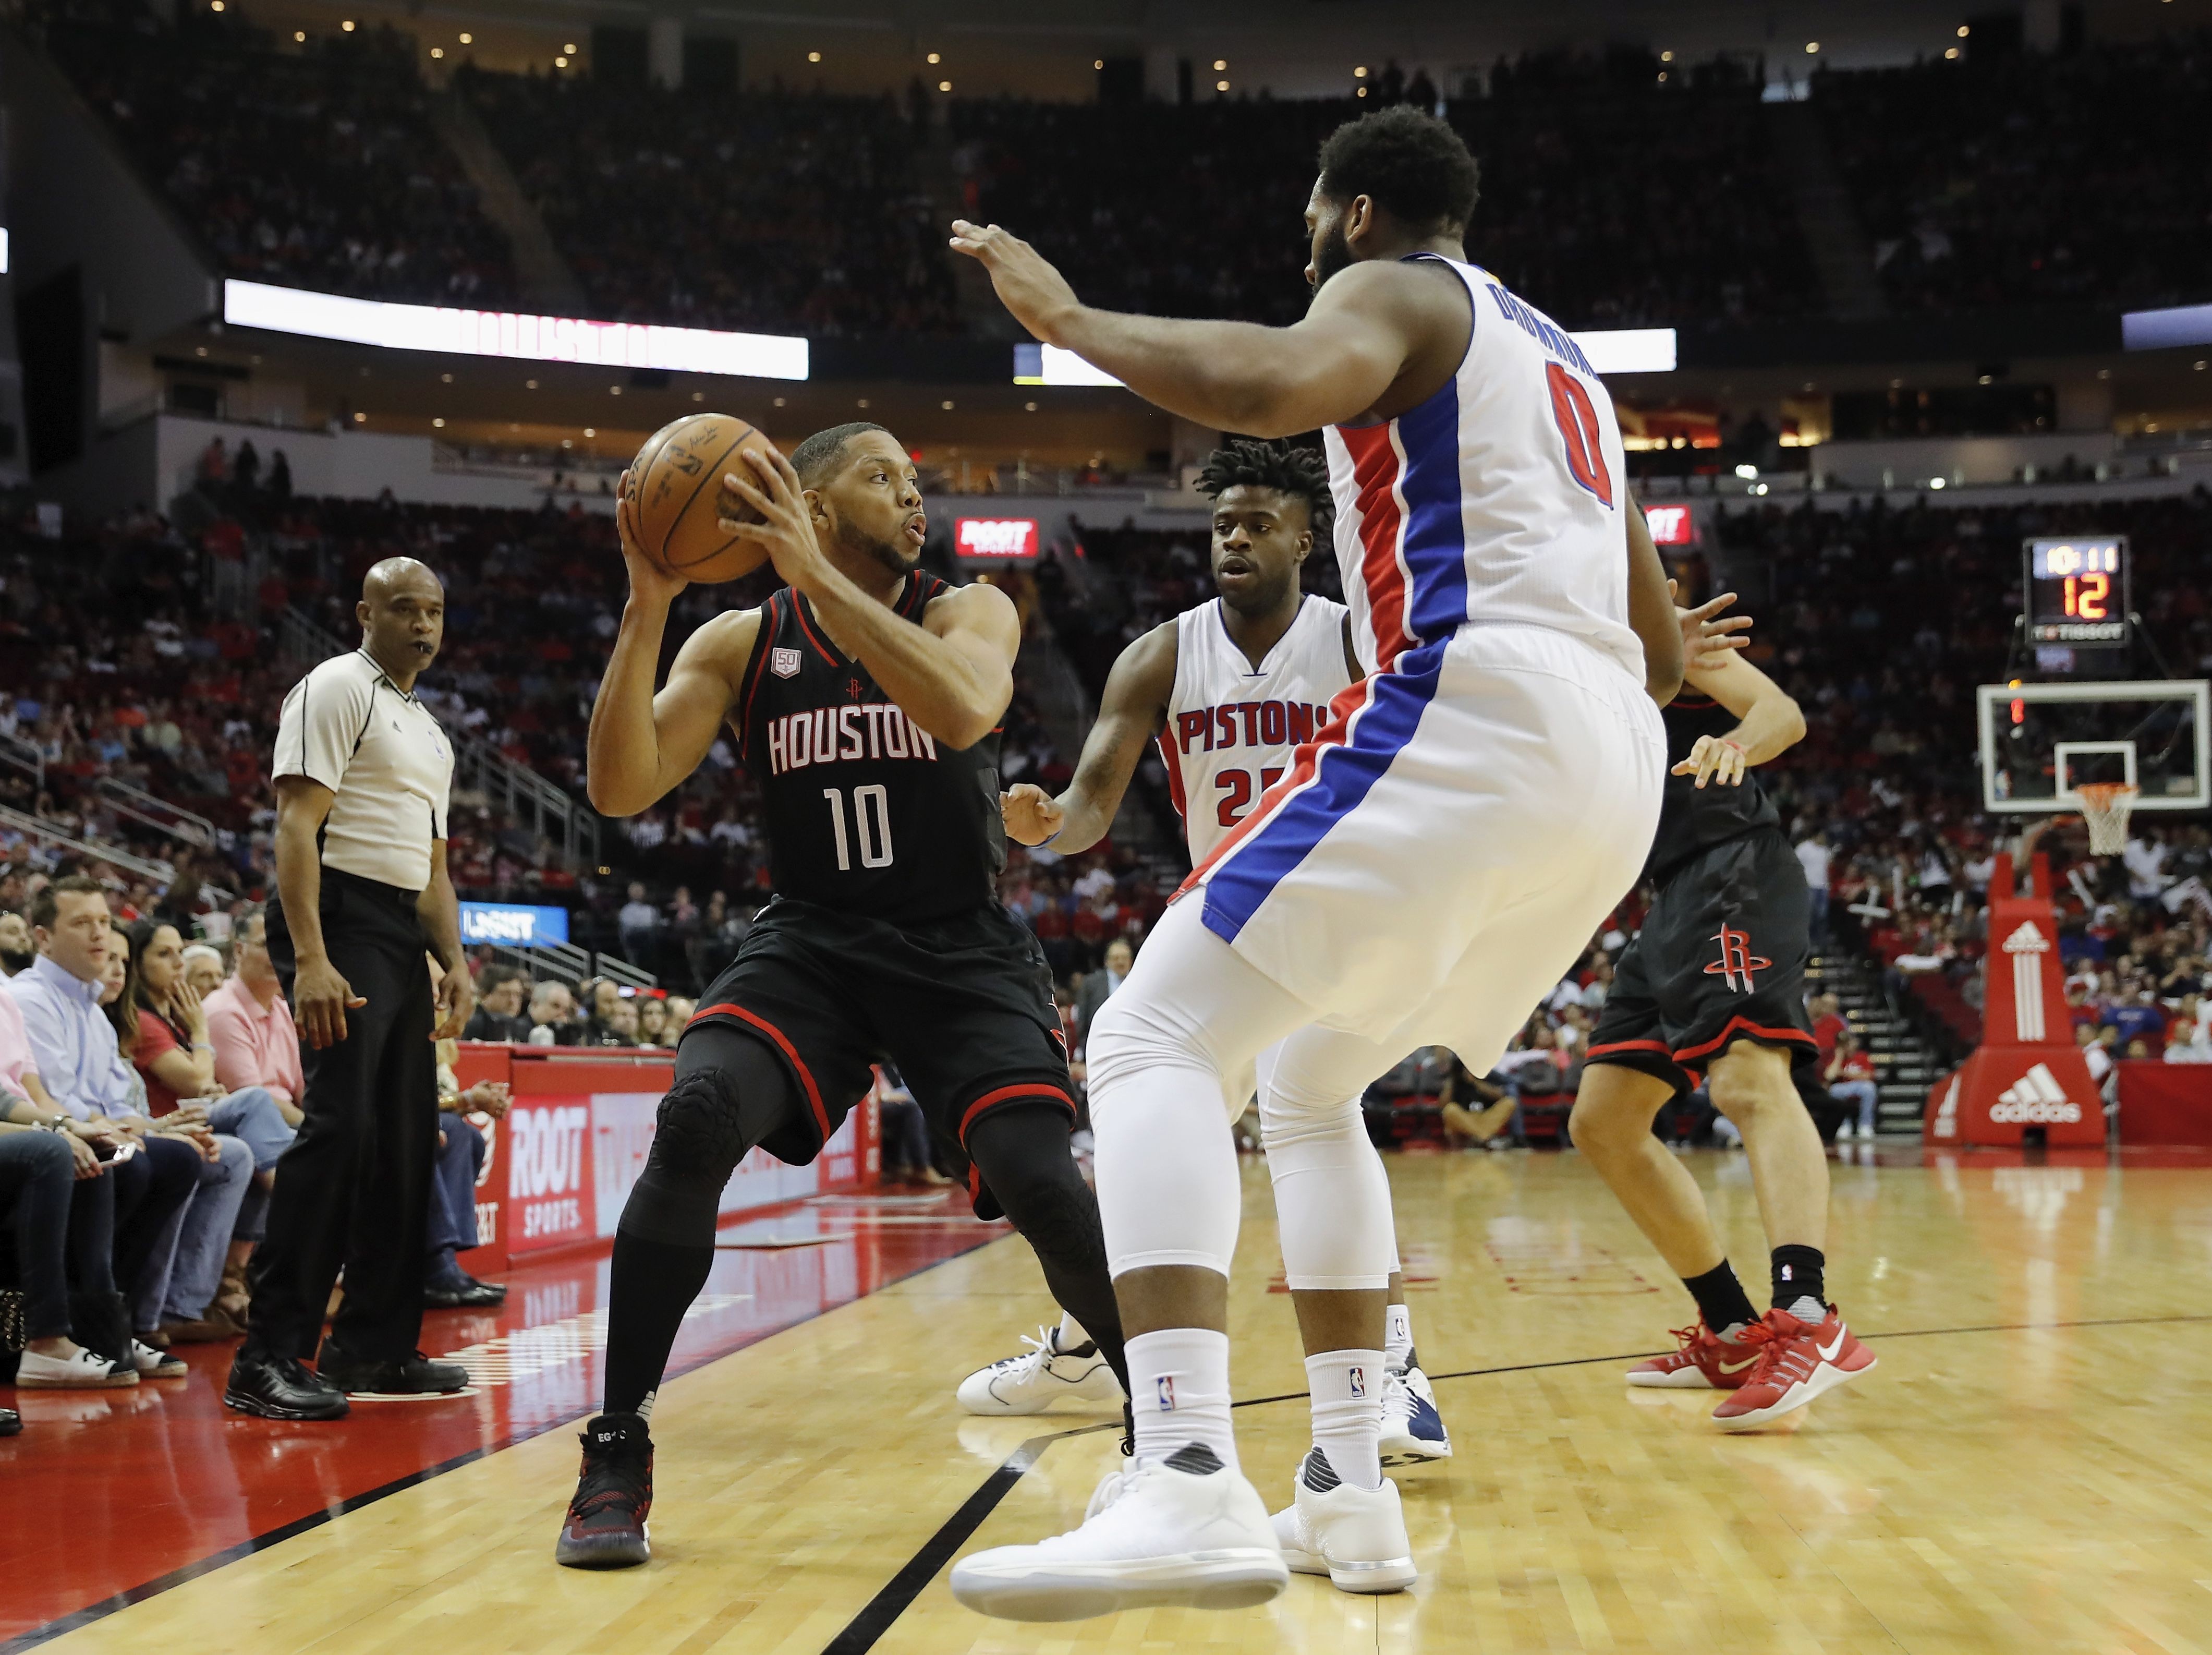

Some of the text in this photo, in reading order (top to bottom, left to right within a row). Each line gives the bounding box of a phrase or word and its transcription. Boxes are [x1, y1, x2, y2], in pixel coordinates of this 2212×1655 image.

[1485, 283, 1600, 382] DRUMMON
[1545, 358, 1614, 510] 0
[961, 521, 1033, 546] ROOT
[2063, 571, 2110, 619] 12
[777, 653, 796, 665] 50
[768, 702, 937, 776] HOUSTON
[823, 784, 893, 871] 10
[1989, 1102, 2082, 1124] adidas
[509, 1106, 587, 1199] ROOT
[474, 1202, 499, 1246] &T
[524, 1198, 582, 1238] SPORTS
